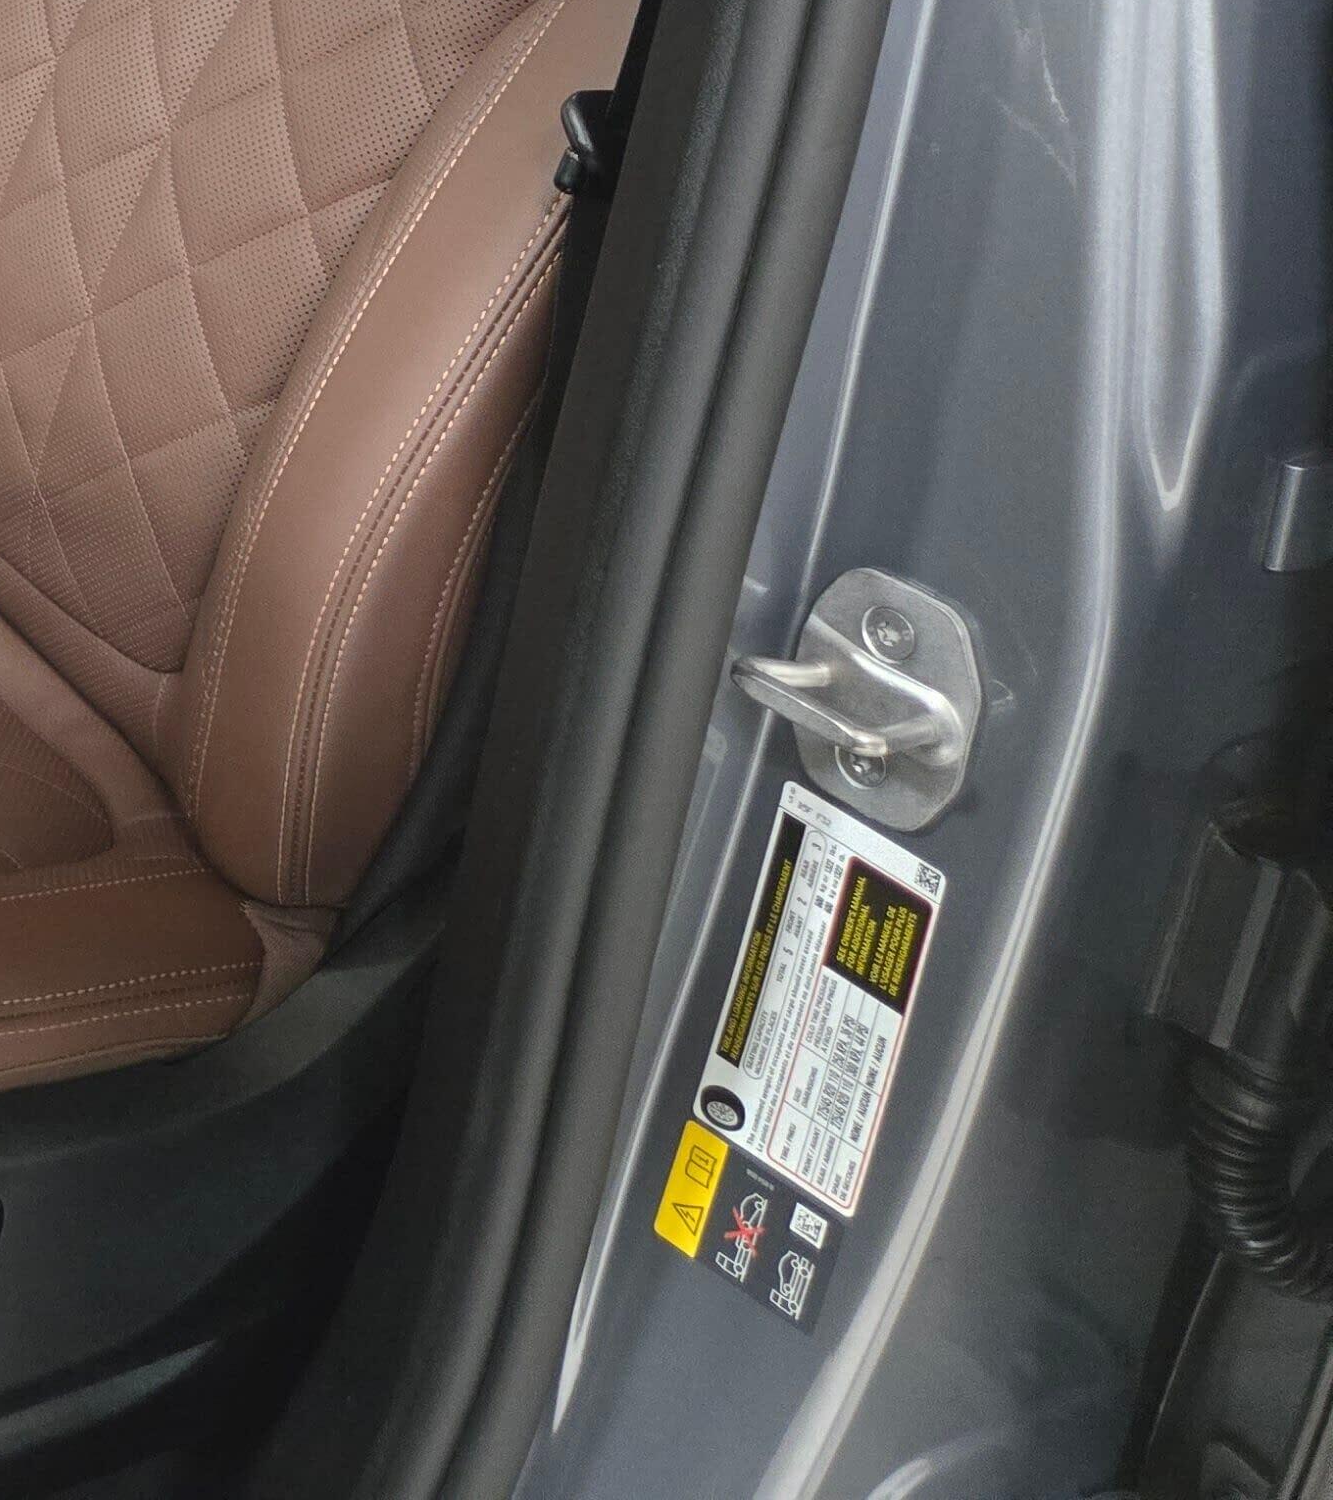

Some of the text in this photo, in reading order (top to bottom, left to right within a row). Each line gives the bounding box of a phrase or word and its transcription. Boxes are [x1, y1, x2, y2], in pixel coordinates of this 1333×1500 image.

[834, 873, 867, 964] SEE OWNER'S MANUAL
[844, 901, 870, 970] FOR ADDITIONAL
[854, 917, 877, 976] INFORMATION
[867, 903, 897, 985] VOIR LE MANUEL DE
[877, 904, 908, 991] L'USAGER POUR PLUS
[887, 910, 918, 997] DE RENSEIGNEMENTS
[864, 1065, 878, 1089] NONE
[871, 1033, 887, 1063] AUCUN
[848, 1118, 863, 1144] NONE
[855, 1088, 872, 1118] AUCUN
